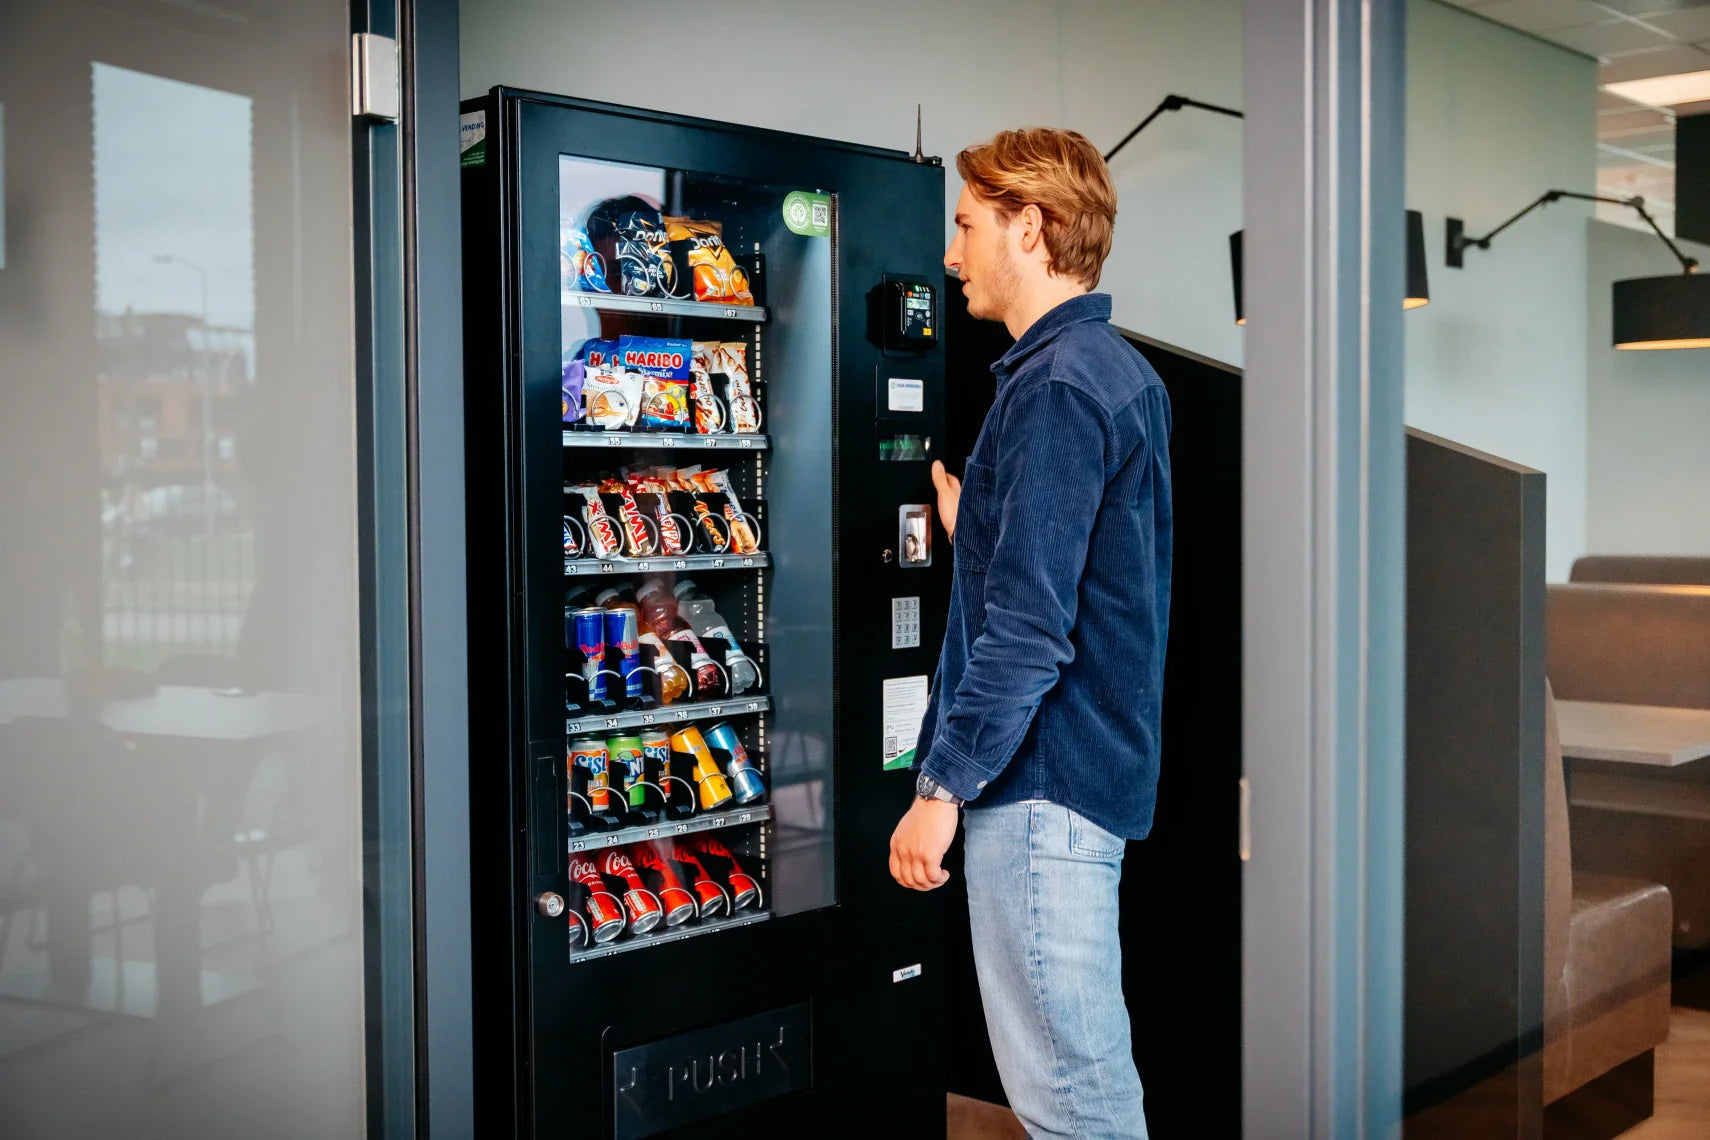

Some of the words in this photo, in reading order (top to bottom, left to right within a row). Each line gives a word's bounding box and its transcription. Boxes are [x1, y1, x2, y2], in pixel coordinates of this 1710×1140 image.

[625, 351, 684, 369] HARIBO
[707, 438, 716, 446] 57
[588, 501, 617, 553] TWX
[660, 516, 680, 549] KitKa
[565, 565, 576, 573] 43
[603, 564, 613, 572] 44
[638, 562, 649, 570] 45
[676, 561, 686, 569] 46
[644, 715, 654, 723] 35
[677, 711, 687, 719] 36
[569, 723, 580, 731] 33
[607, 719, 618, 727] 34
[715, 818, 725, 826] 27
[649, 829, 659, 837] 25
[607, 836, 618, 844] 24
[573, 841, 585, 849] 23
[668, 1042, 761, 1101] PUSH
